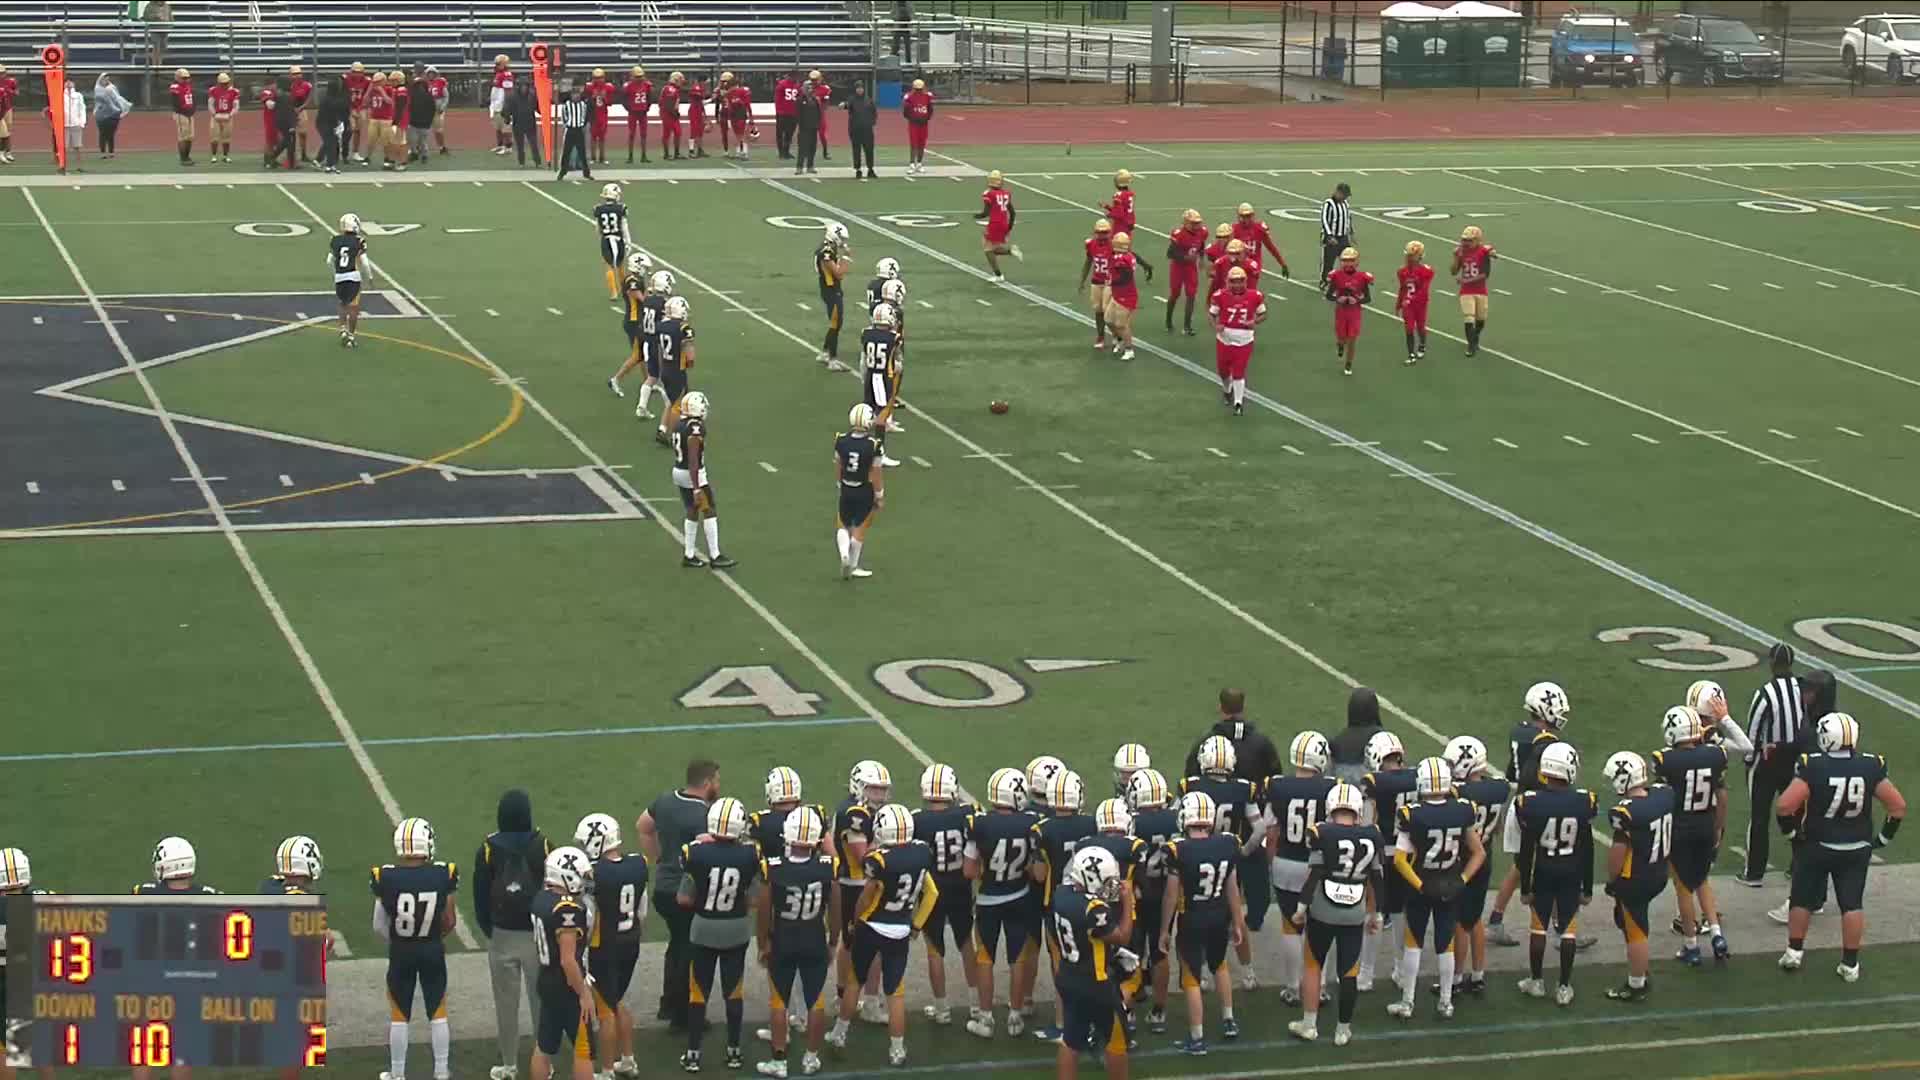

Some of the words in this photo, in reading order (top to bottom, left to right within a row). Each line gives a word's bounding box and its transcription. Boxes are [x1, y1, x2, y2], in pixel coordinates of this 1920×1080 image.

[634, 92, 647, 104] 22
[600, 212, 620, 235] 33
[996, 194, 1010, 213] 42
[1227, 307, 1250, 325] 73
[865, 341, 888, 370] 85
[848, 451, 860, 473] 3
[1683, 768, 1712, 812] 15
[1824, 776, 1866, 819] 79
[1287, 798, 1317, 847] 61
[1540, 817, 1578, 856] 49
[1649, 812, 1673, 864] 70
[935, 829, 963, 872] 13
[989, 838, 1027, 881] 42
[1332, 838, 1375, 880] 32
[1423, 827, 1462, 870] 25
[704, 867, 740, 912] 18
[780, 881, 823, 921] 30
[1193, 860, 1229, 901] 31
[395, 892, 437, 937] 87
[617, 883, 635, 932] 9
